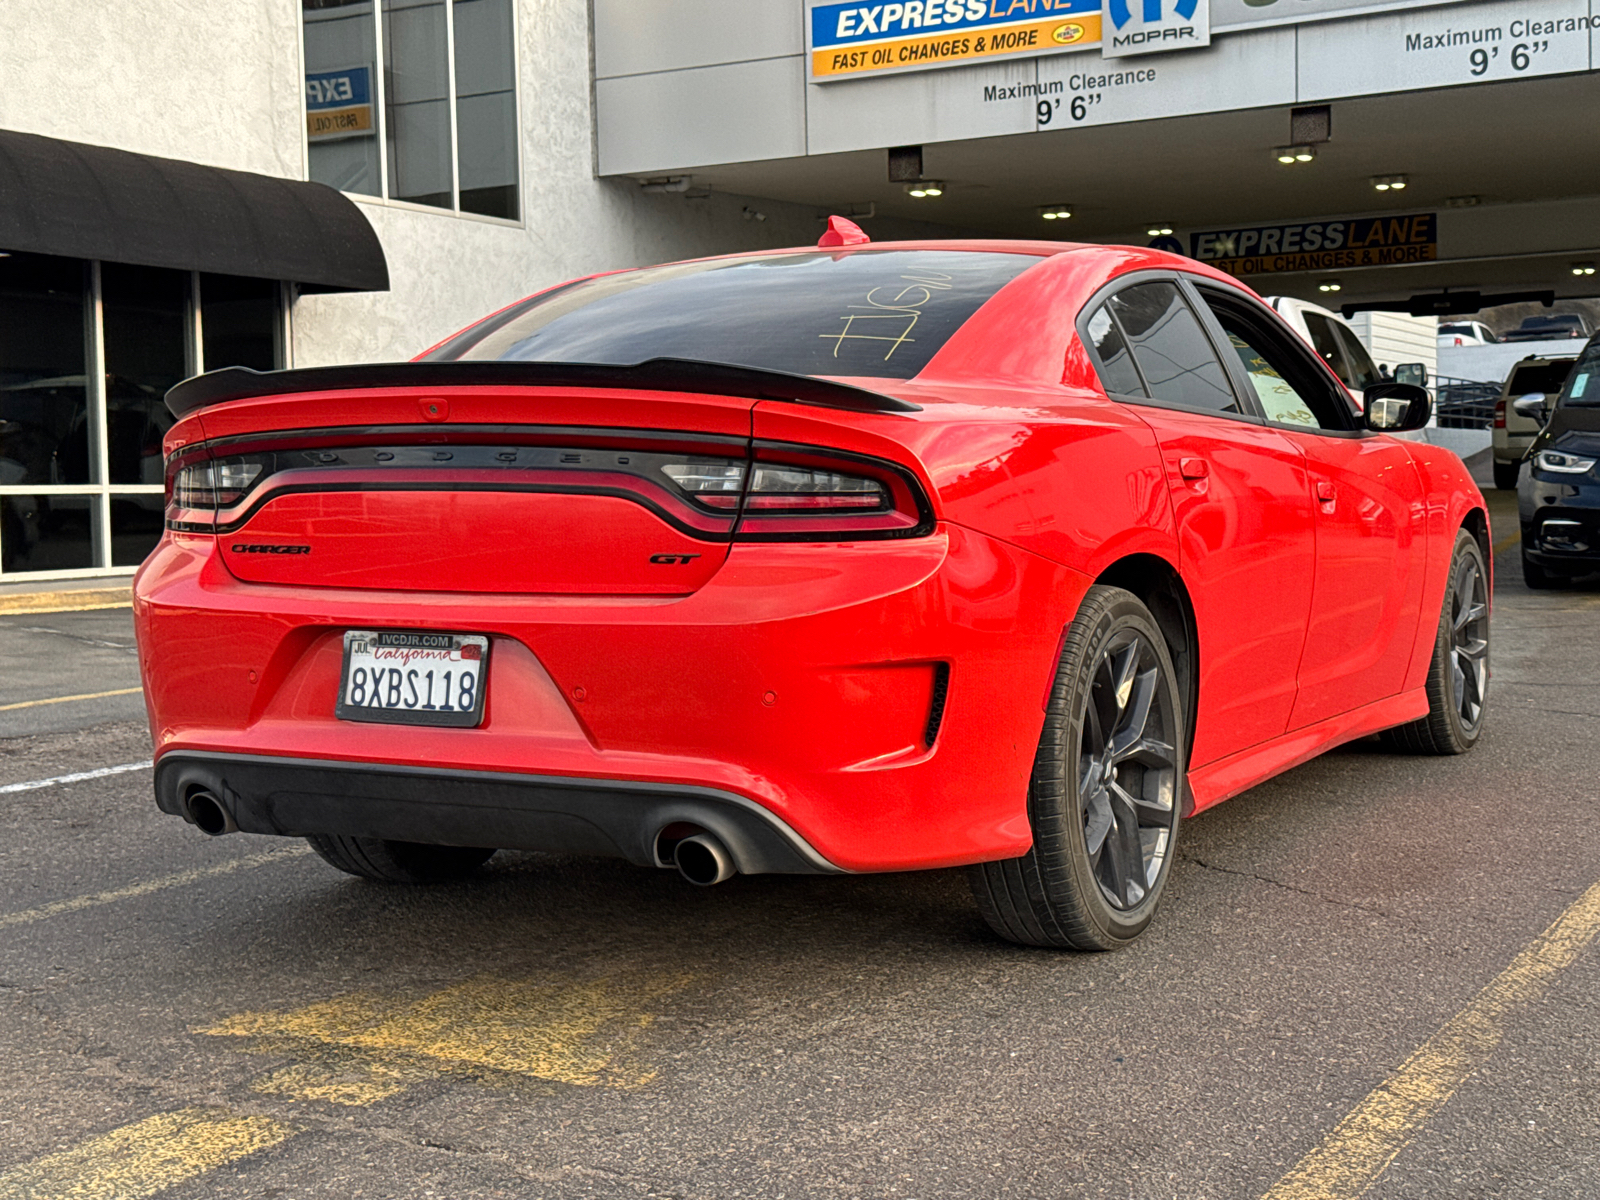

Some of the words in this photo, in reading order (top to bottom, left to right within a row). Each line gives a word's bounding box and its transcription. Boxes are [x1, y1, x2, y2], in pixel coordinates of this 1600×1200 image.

[1113, 26, 1194, 48] MOPAR
[1406, 25, 1502, 52] Maximum
[1509, 14, 1600, 38] Clearanc
[832, 50, 869, 70] FAST
[872, 48, 894, 65] OIL
[898, 36, 970, 62] CHANGES
[974, 37, 986, 52] &
[990, 29, 1039, 50] MORE
[984, 80, 1064, 102] Maximum
[1069, 68, 1157, 91] Clearance
[1242, 256, 1270, 275] OIL
[1273, 249, 1357, 272] CHANGES
[1361, 250, 1372, 263] &
[1378, 244, 1431, 263] MORE
[319, 451, 582, 464] DODGE
[231, 544, 312, 555] CHARGER
[649, 553, 702, 565] GT
[354, 641, 371, 655] JUL
[381, 633, 450, 648] IVCDJR.COM
[374, 646, 461, 667] California
[350, 667, 475, 713] 8XBS118
